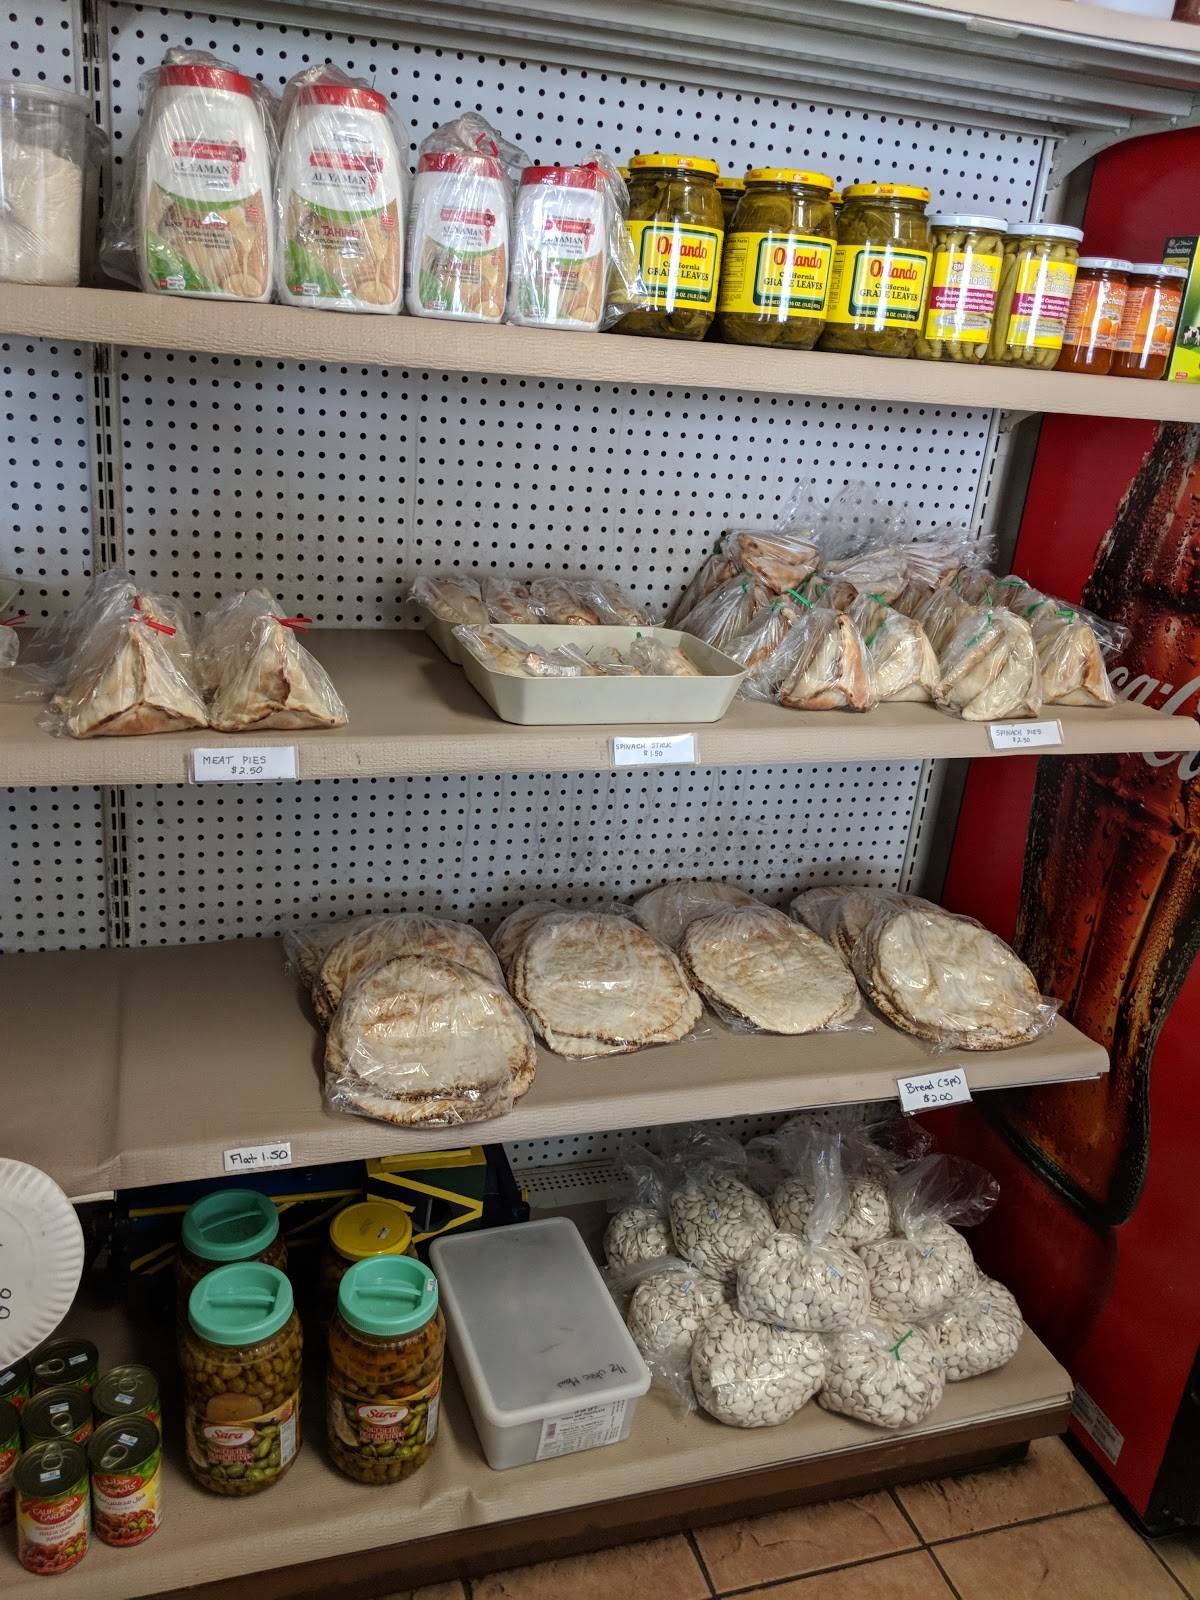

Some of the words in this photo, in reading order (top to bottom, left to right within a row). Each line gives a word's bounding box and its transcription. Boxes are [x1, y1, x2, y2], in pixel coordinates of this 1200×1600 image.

[657, 235, 708, 260] Orando
[663, 260, 700, 271] Cfornia
[647, 267, 677, 278] GRA
[681, 269, 709, 282] LEAVES
[779, 271, 815, 281] Cifornia
[763, 277, 795, 289] GRAE
[796, 280, 823, 291] LEAVES
[875, 282, 911, 292] Clifornia
[859, 288, 891, 299] GRAE
[891, 291, 919, 302] LEAVES
[202, 755, 234, 765] MEAT
[242, 755, 267, 765] PIES
[231, 766, 264, 775] $2.50
[904, 1080, 935, 1095] Bread
[922, 1092, 953, 1103] $2.00
[229, 1152, 257, 1165] Flat
[261, 1149, 288, 1162] 1.50
